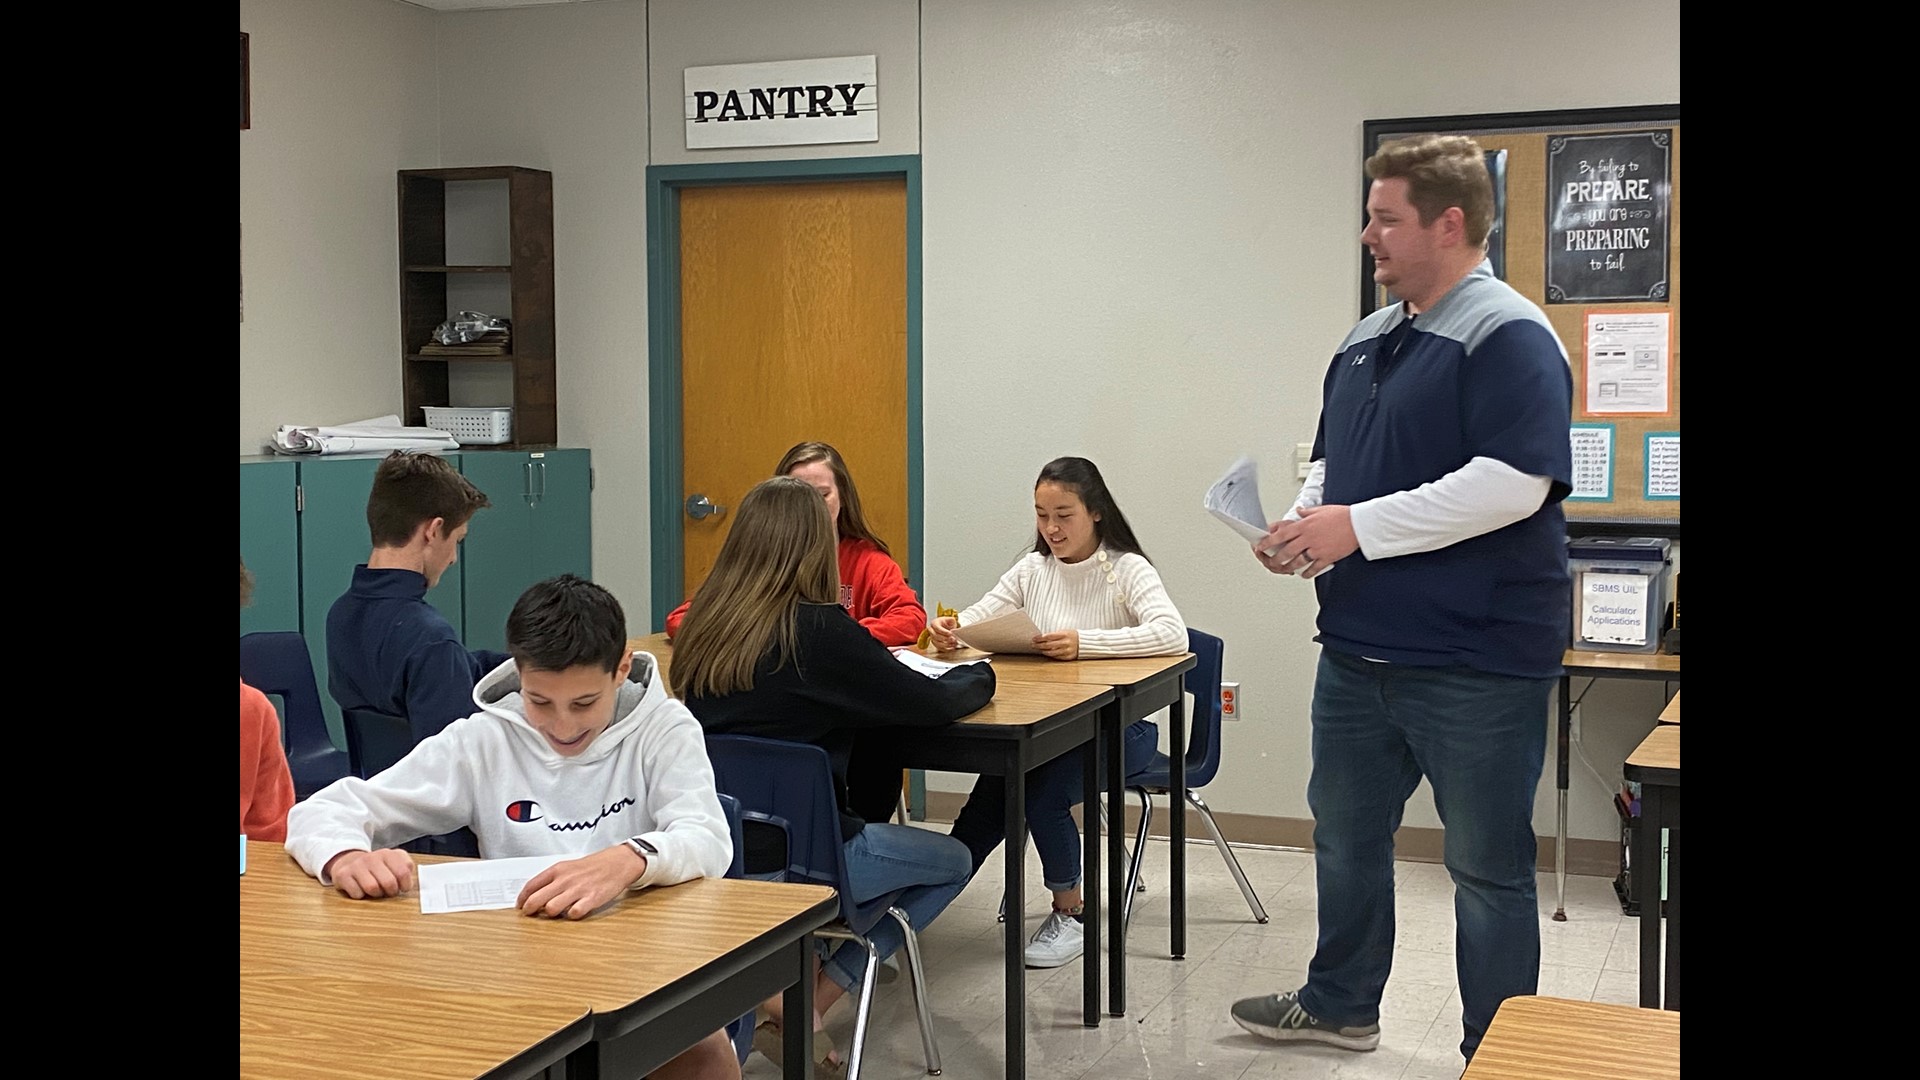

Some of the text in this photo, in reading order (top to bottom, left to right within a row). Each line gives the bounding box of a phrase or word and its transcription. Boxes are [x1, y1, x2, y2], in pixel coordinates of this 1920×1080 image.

[694, 83, 865, 123] PANTRY
[1579, 158, 1639, 179] By failing to
[1588, 208, 1627, 227] you are
[1565, 227, 1650, 251] PREPARING
[1590, 259, 1601, 270] to
[1592, 584, 1639, 594] SBMS UIL
[1592, 605, 1637, 615] Calculator
[1587, 616, 1641, 626] Applications
